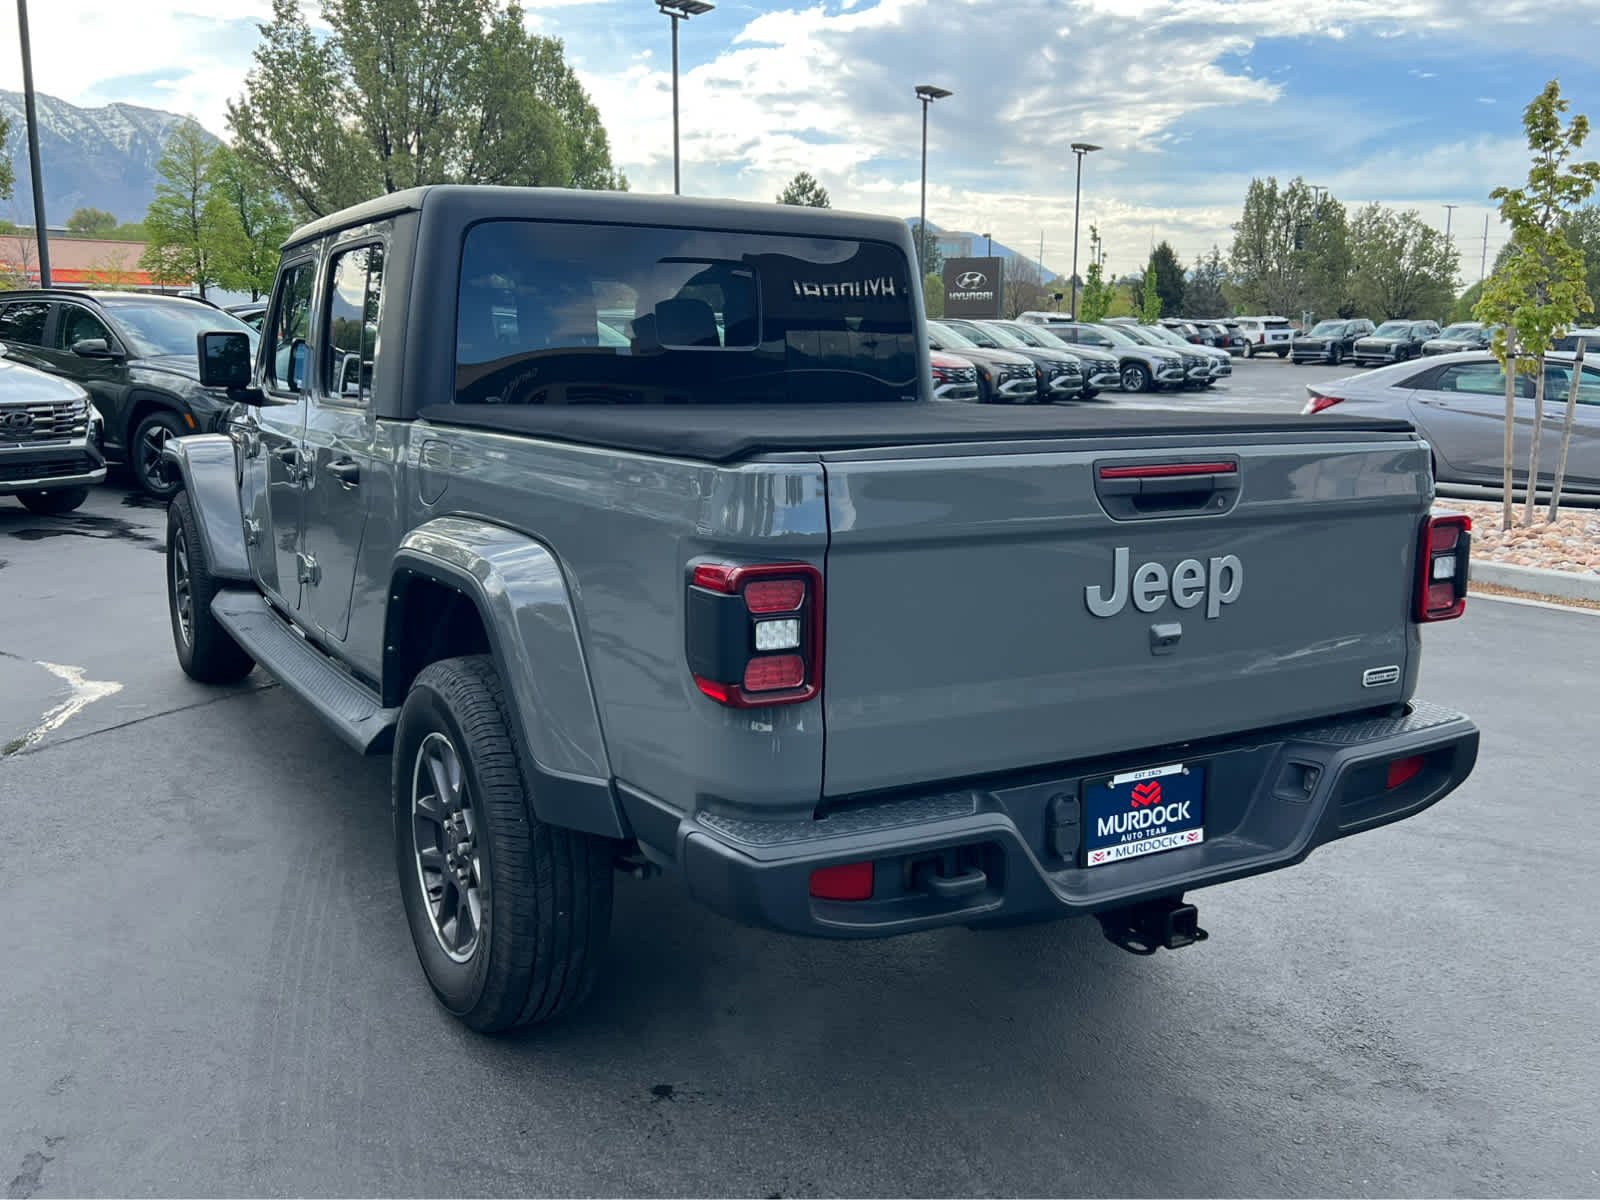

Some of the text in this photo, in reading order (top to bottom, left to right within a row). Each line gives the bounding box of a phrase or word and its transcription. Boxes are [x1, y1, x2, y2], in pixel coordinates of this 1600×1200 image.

[949, 291, 993, 301] HYUNDAI
[1085, 547, 1243, 620] Jeep
[1098, 801, 1190, 837] MURDOCK
[1120, 826, 1167, 843] AUTO TEAM
[1115, 835, 1178, 858] MURDOCK
